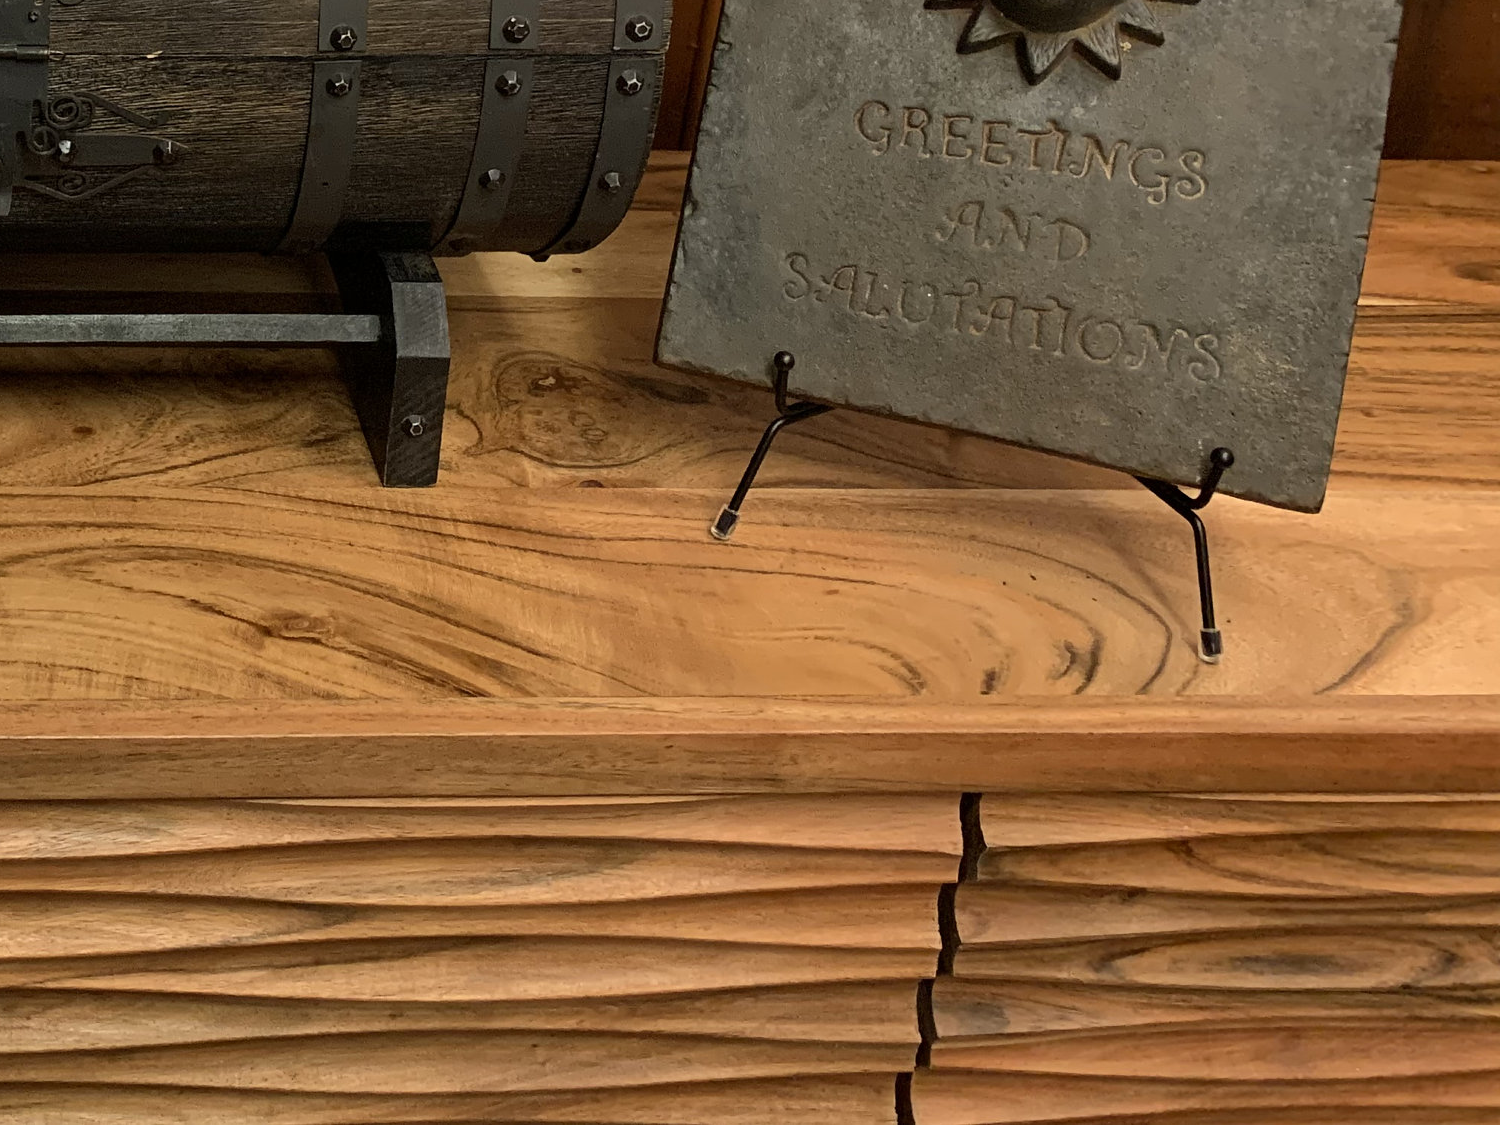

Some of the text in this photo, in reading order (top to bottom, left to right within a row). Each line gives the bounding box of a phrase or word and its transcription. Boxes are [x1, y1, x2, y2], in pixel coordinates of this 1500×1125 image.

[854, 100, 1209, 205] GREETINGS
[935, 199, 1091, 262] AND
[781, 252, 1222, 382] SALUTATIONS
